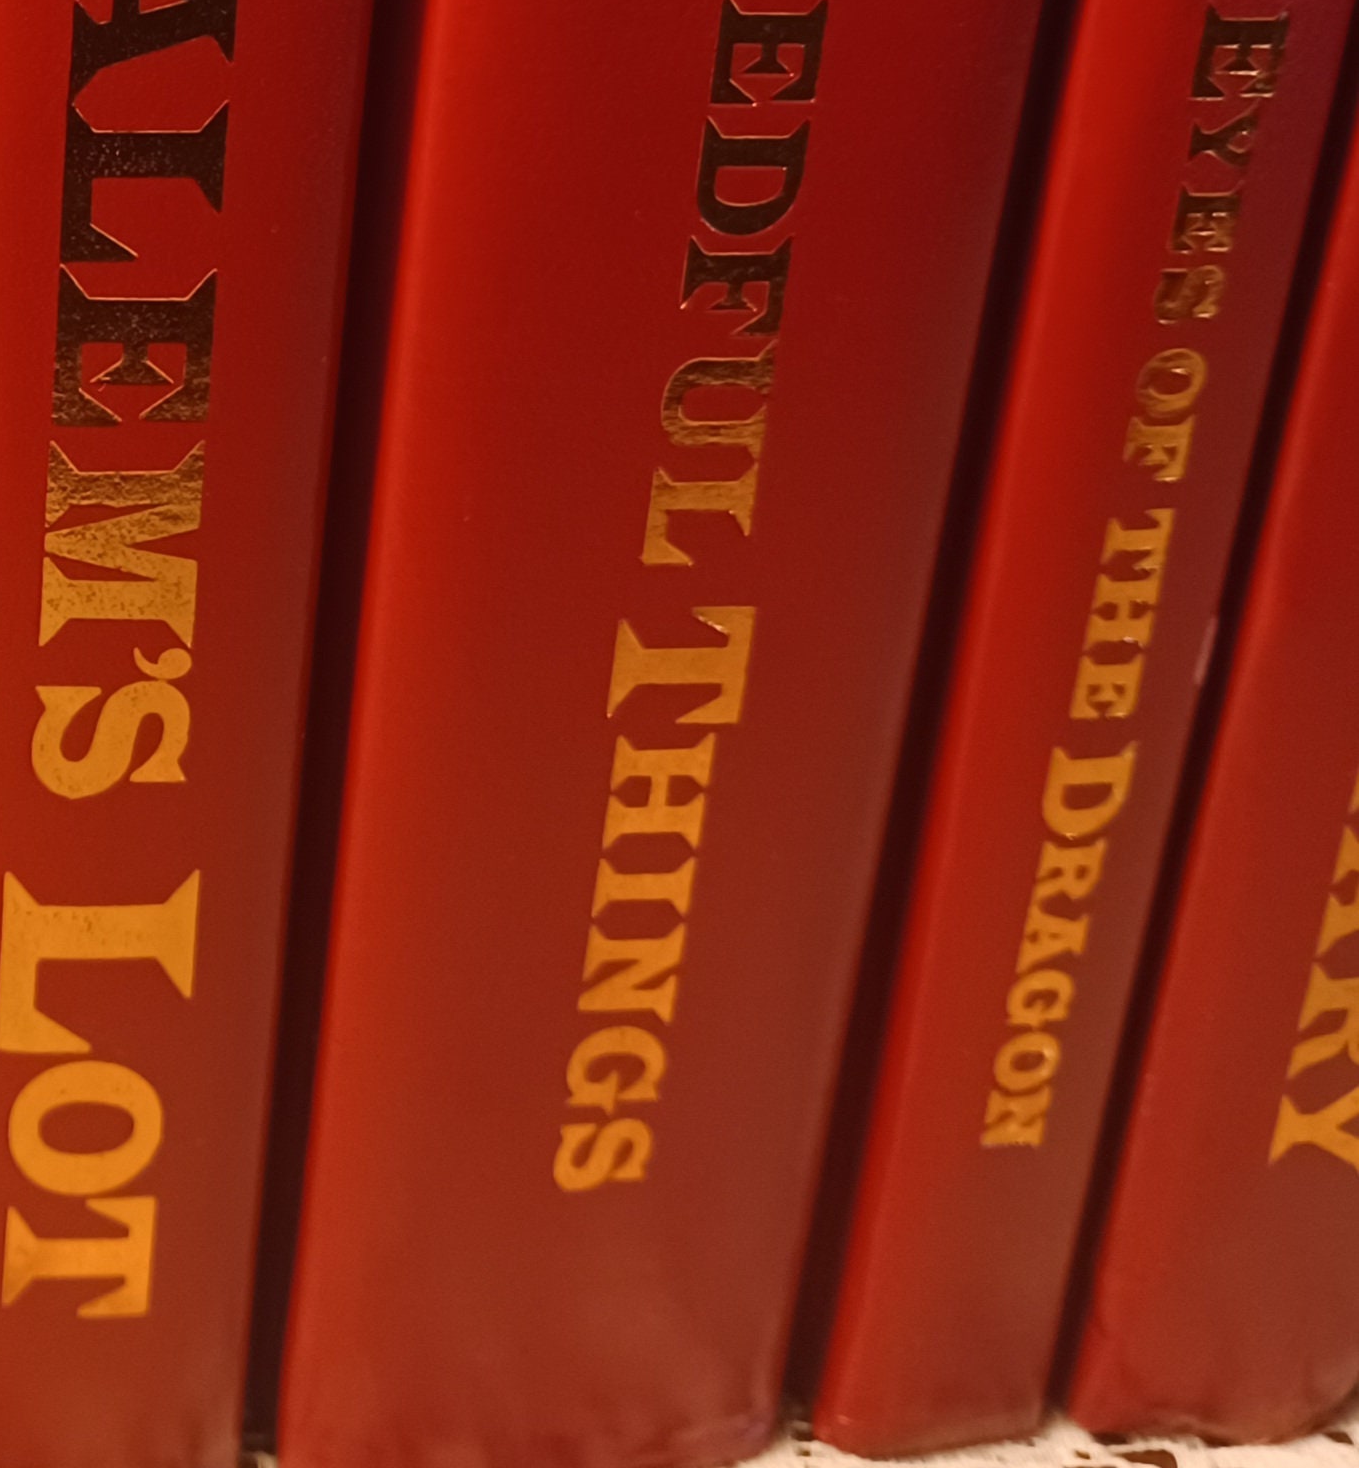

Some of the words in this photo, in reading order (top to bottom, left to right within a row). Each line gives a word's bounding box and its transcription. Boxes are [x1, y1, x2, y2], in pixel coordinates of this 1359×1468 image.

[1153, 2, 1289, 324] EYES
[1122, 347, 1208, 482] OF
[1069, 507, 1177, 721] THE
[553, 605, 757, 1192] THINGS
[979, 740, 1140, 1148] DRAGON
